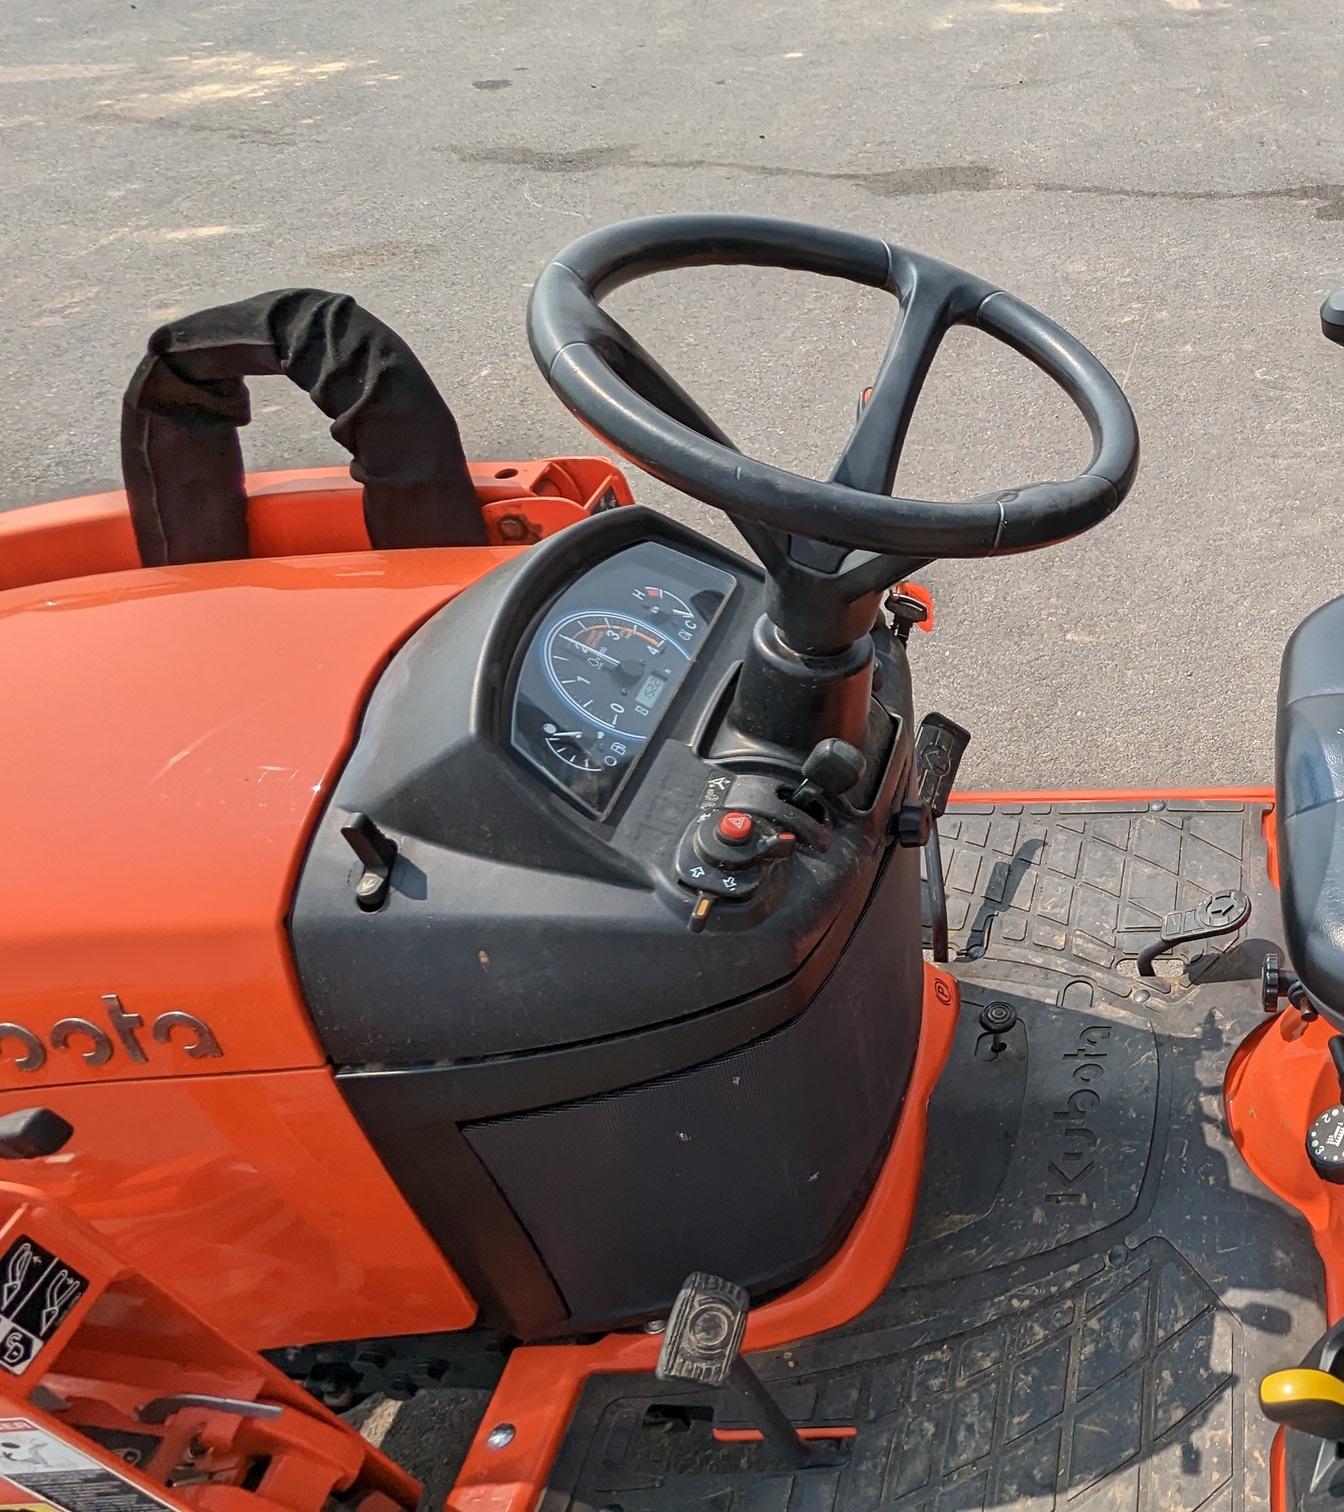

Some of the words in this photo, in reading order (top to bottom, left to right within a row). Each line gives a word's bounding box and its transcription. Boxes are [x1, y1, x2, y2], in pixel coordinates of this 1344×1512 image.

[632, 588, 645, 600] H
[684, 619, 697, 630] C
[606, 630, 620, 641] 3
[646, 645, 660, 655] 4
[577, 675, 591, 685] 1
[610, 702, 624, 714] 0
[1044, 1025, 1112, 1203] Kubota
[1321, 1113, 1331, 1124] 2
[1314, 1145, 1325, 1155] 3
